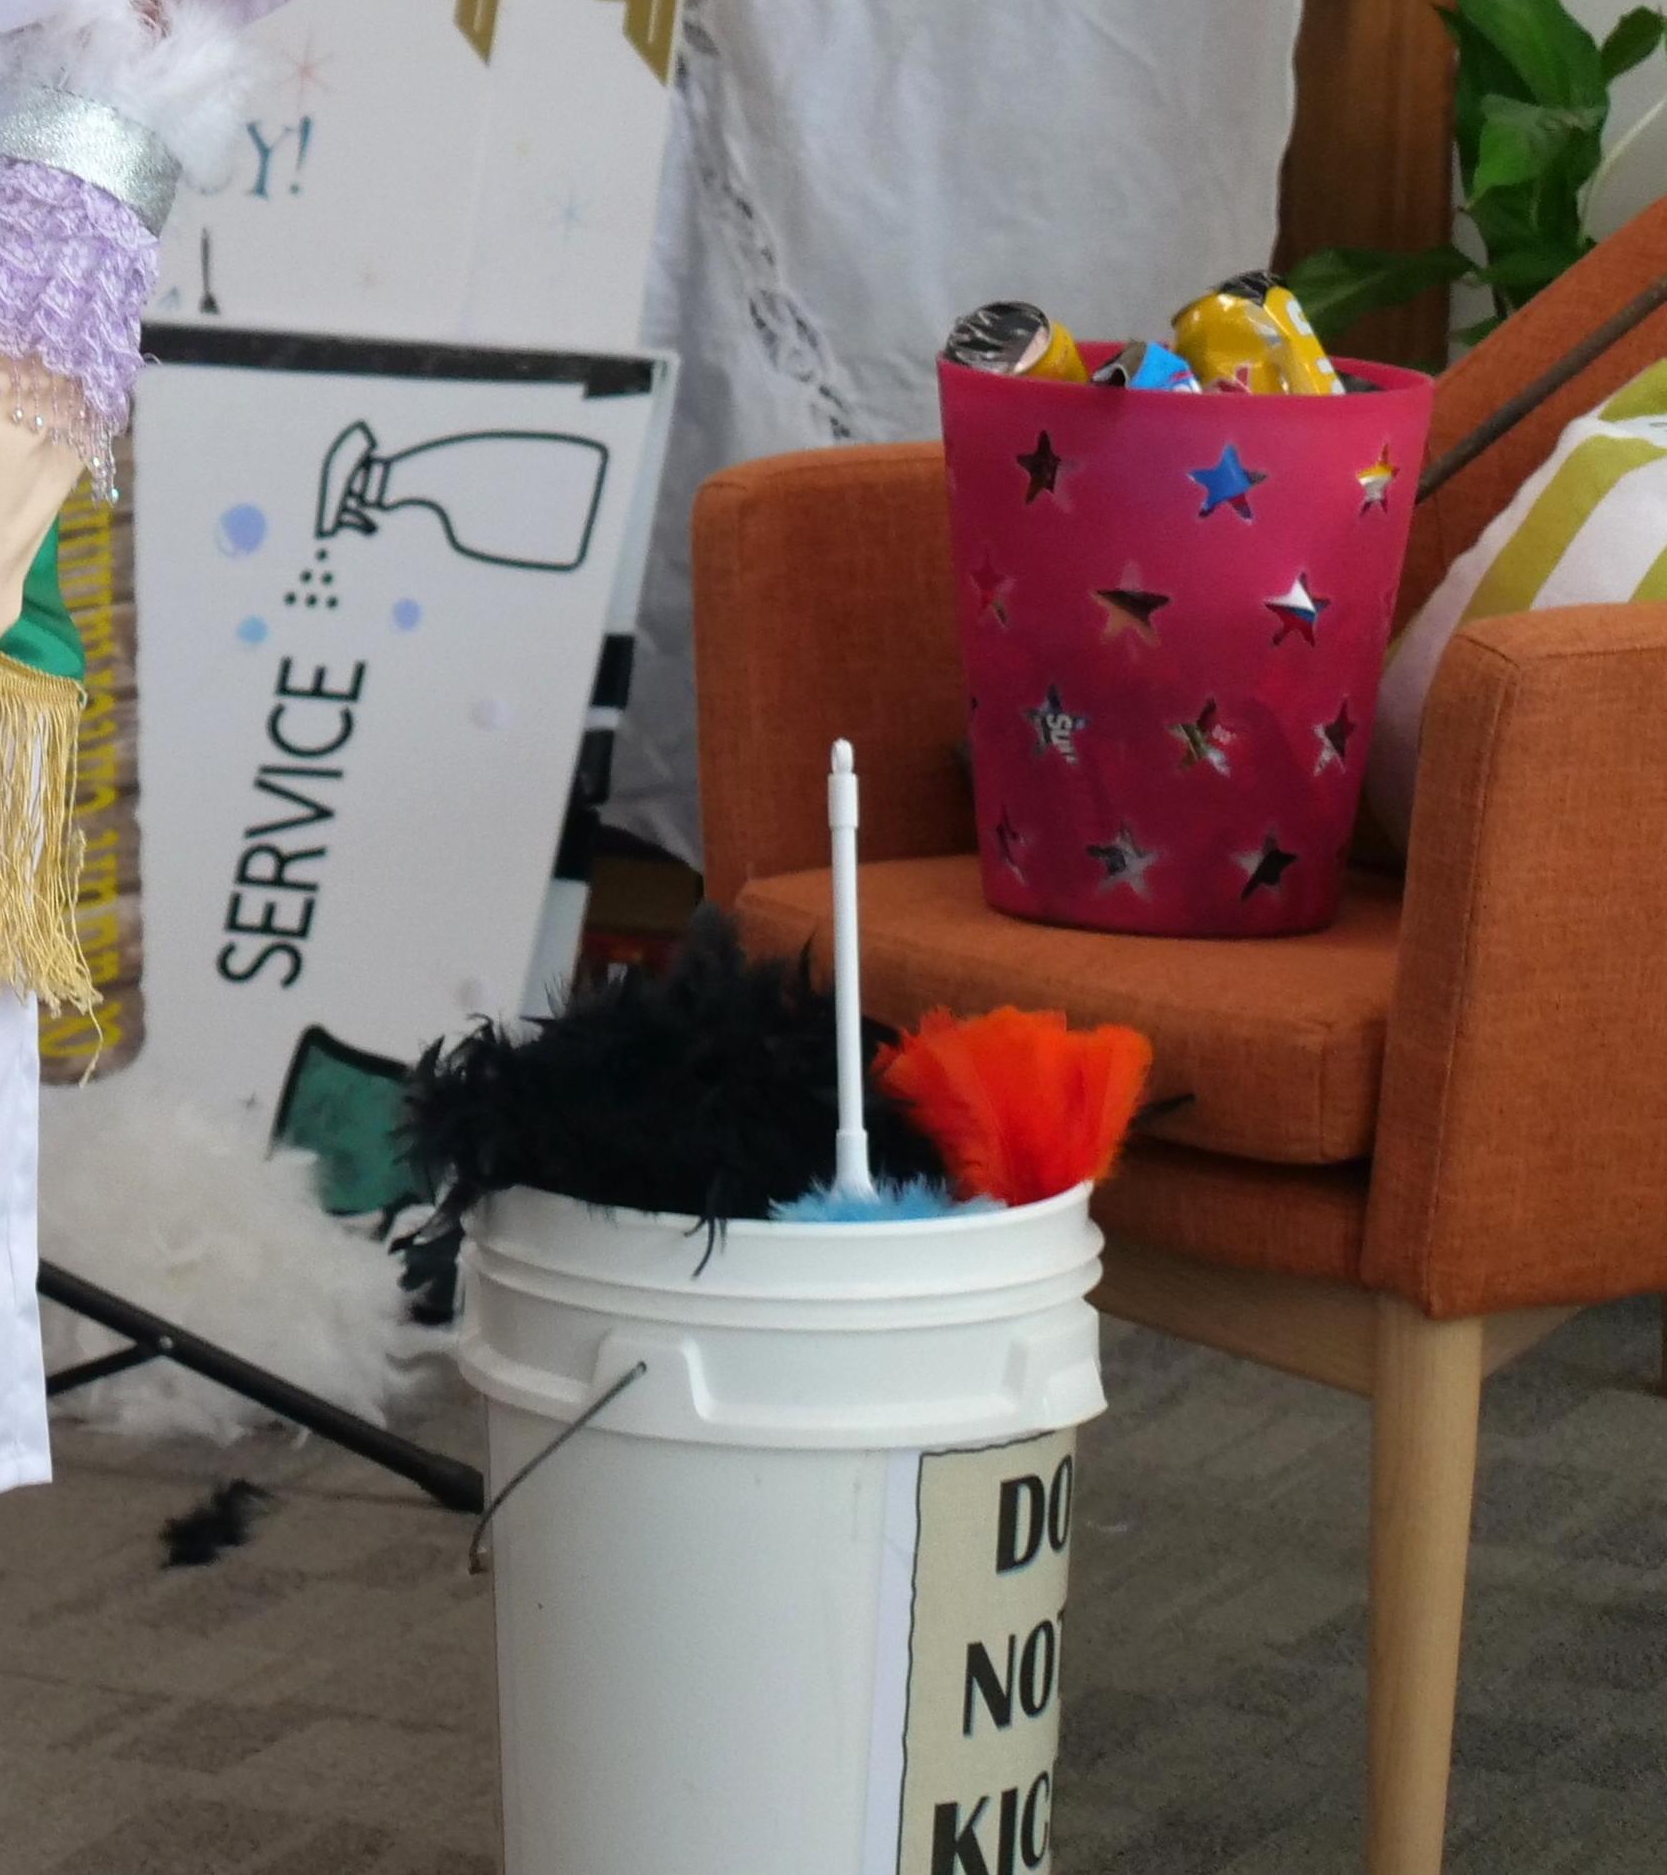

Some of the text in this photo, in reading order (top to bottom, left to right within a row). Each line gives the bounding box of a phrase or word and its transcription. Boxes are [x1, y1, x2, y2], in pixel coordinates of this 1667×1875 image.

[219, 115, 314, 201] Y!
[217, 655, 366, 990] SERVICE
[996, 1454, 1073, 1574] DO
[963, 1608, 1066, 1738] NO
[931, 1770, 1051, 1875] KIC
